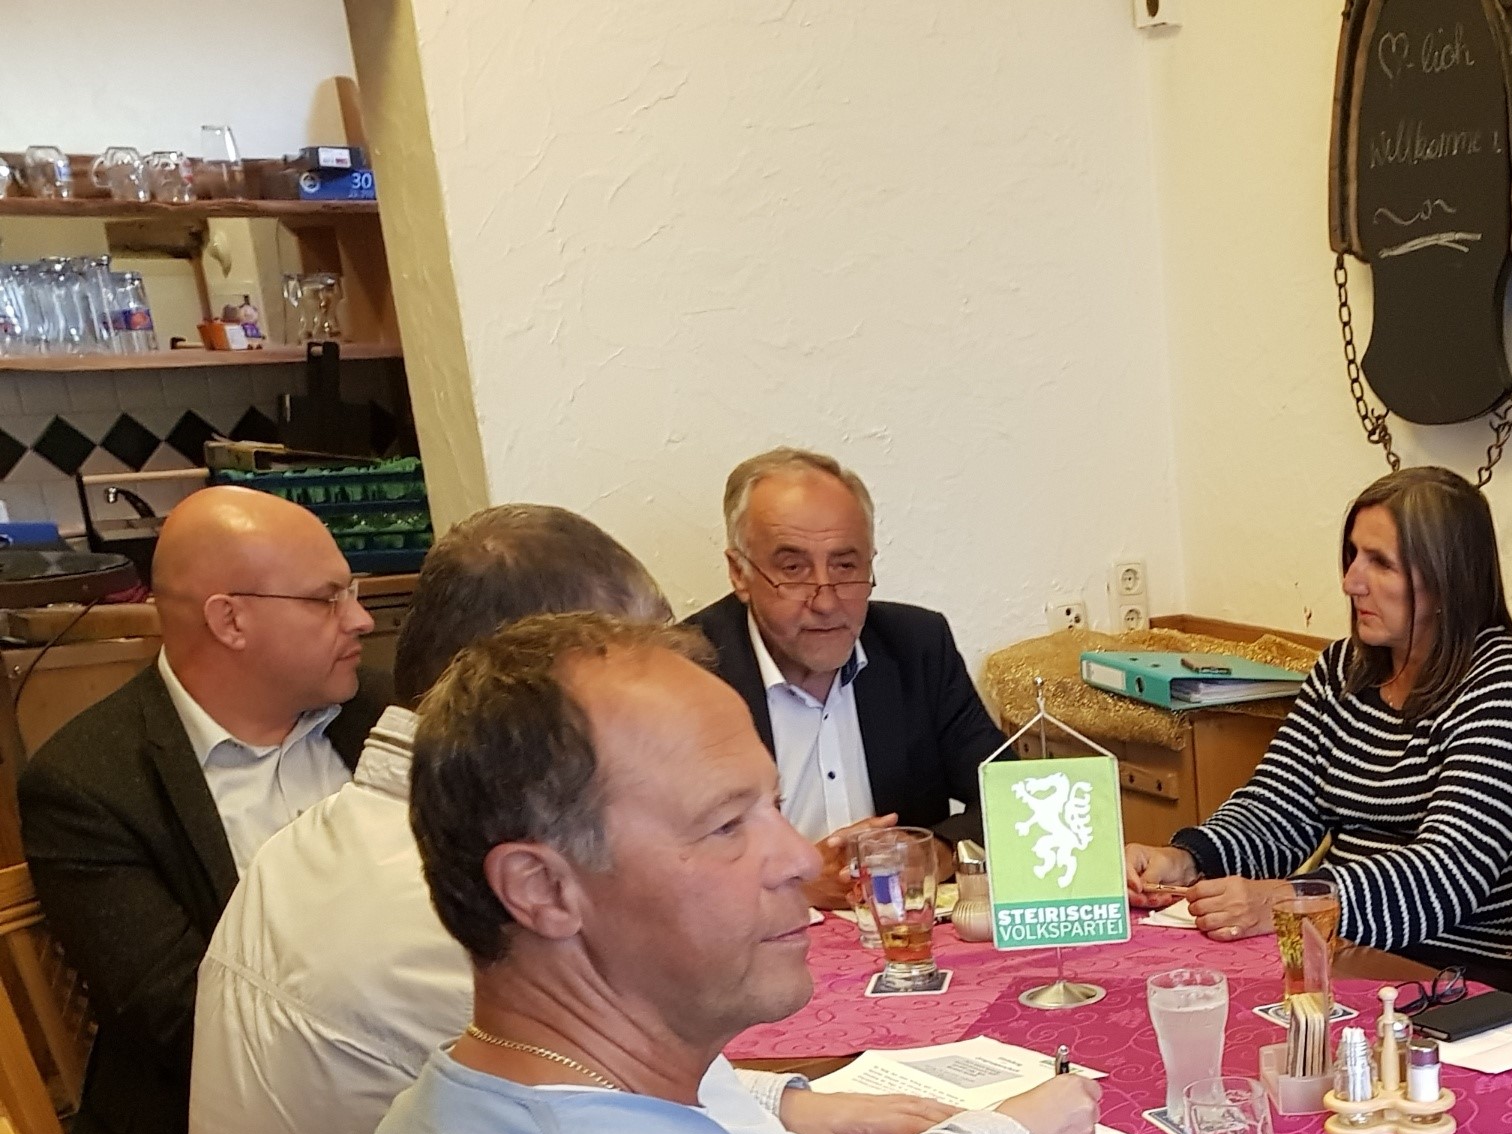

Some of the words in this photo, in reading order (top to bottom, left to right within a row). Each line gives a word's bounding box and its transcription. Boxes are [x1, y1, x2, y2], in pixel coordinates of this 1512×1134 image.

[351, 172, 372, 189] 30
[997, 903, 1121, 926] STEIRISCHE
[999, 919, 1123, 941] VOLKSPARTEI
